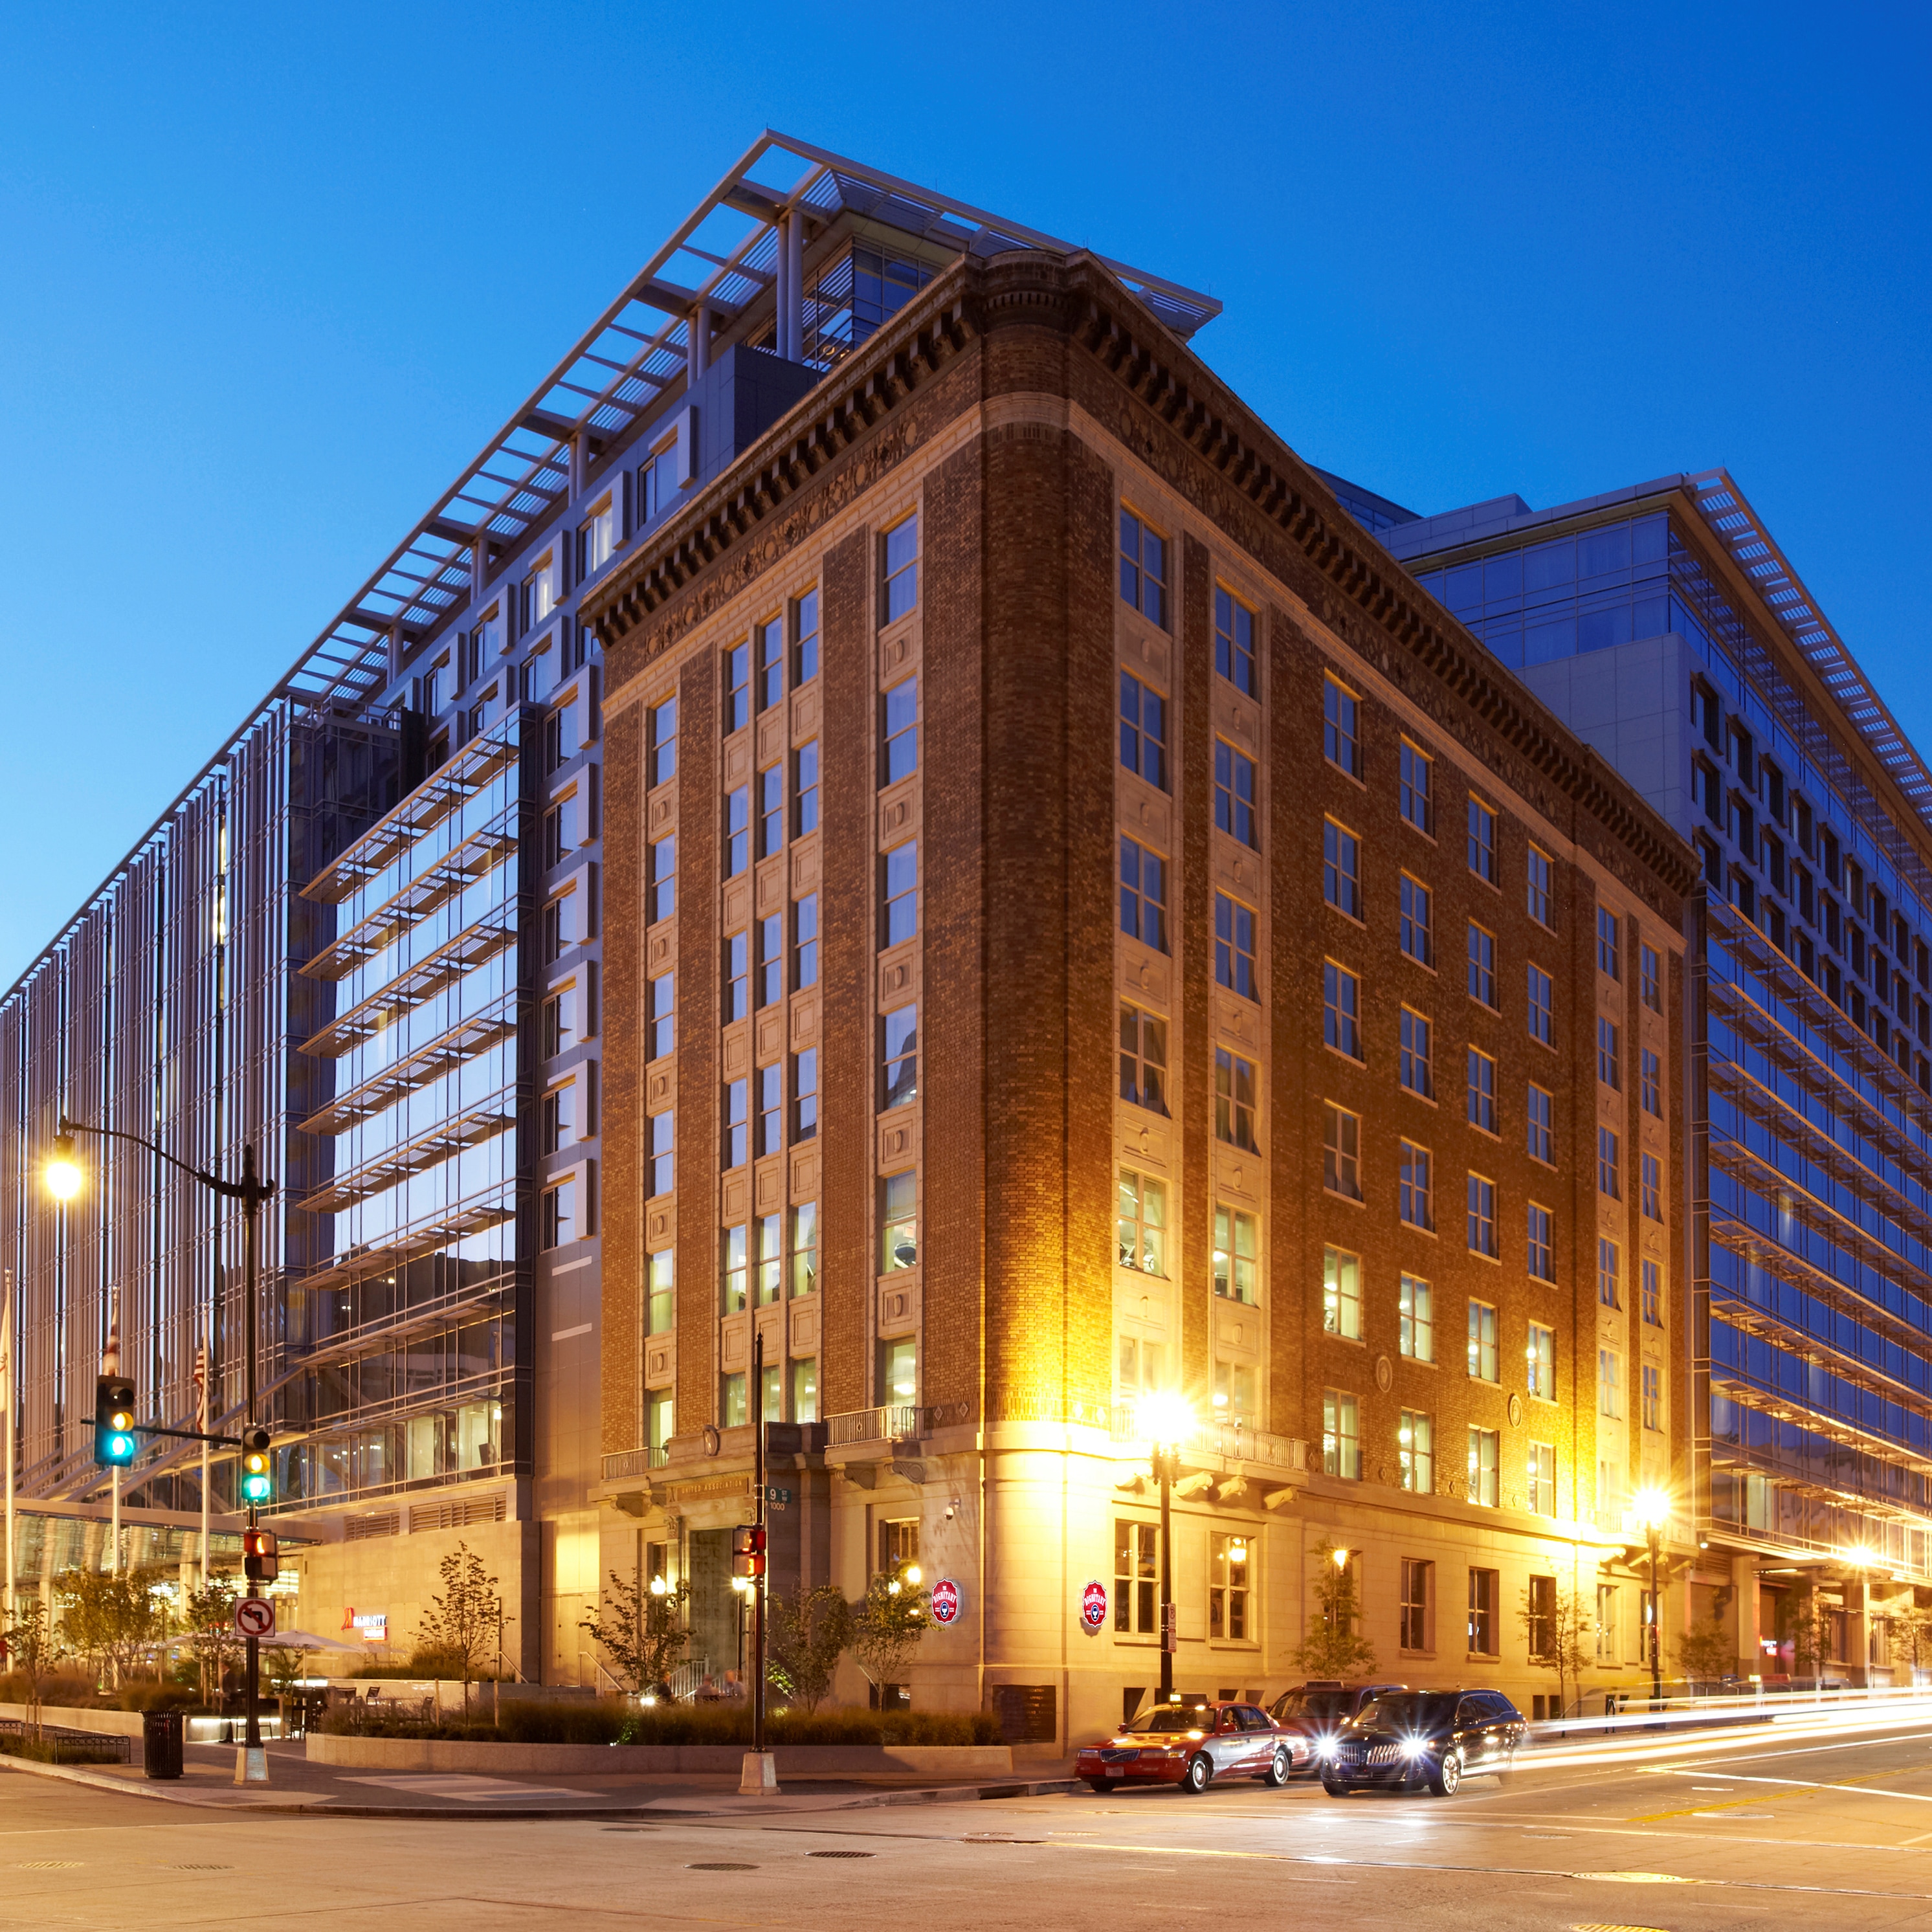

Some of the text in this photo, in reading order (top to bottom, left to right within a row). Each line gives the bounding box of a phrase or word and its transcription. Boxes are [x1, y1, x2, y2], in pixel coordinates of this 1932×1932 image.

[682, 1480, 742, 1494] UNITED ASSOCIATION
[770, 1488, 777, 1500] 9
[770, 1502, 785, 1511] 1000
[933, 1591, 957, 1603] DIGNITARY
[1084, 1593, 1105, 1606] DIGNITARY
